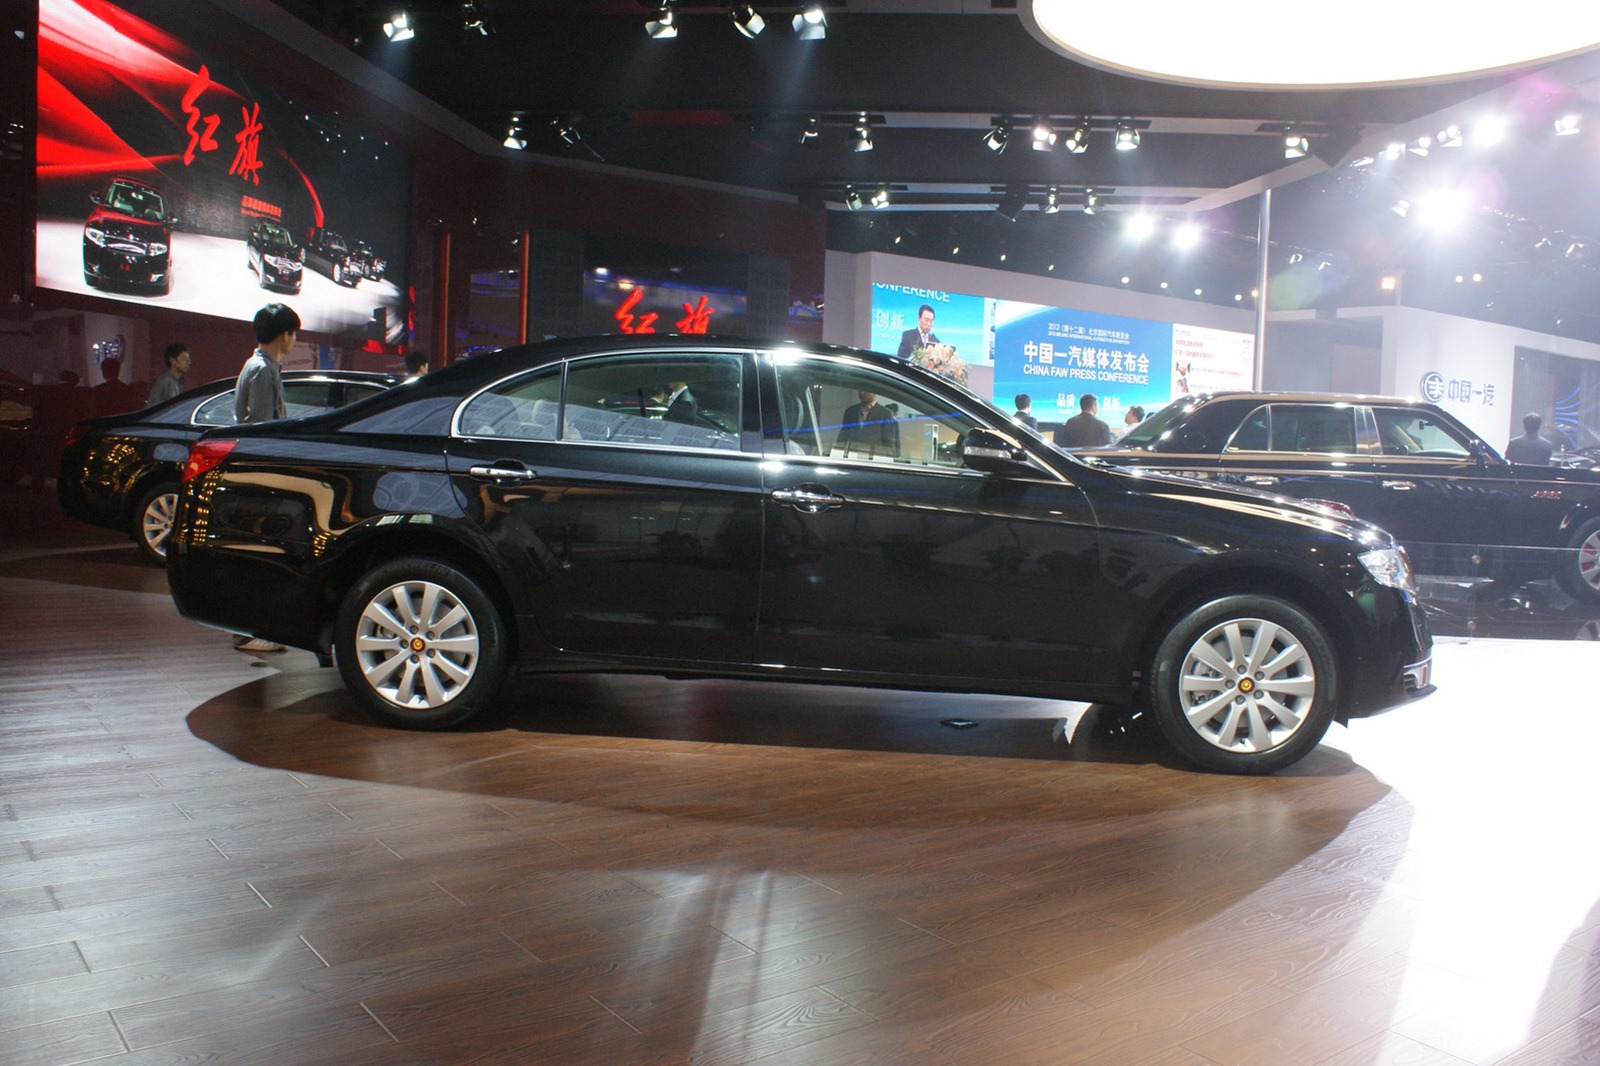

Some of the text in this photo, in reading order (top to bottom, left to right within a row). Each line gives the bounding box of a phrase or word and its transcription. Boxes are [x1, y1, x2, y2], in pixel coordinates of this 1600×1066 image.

[872, 282, 950, 303] NFERENCE
[875, 309, 904, 331] 创新
[1023, 341, 1150, 373] 中国一汽媒体发布会
[1023, 364, 1149, 385] CHINA FAW PRESS CONFERENCE
